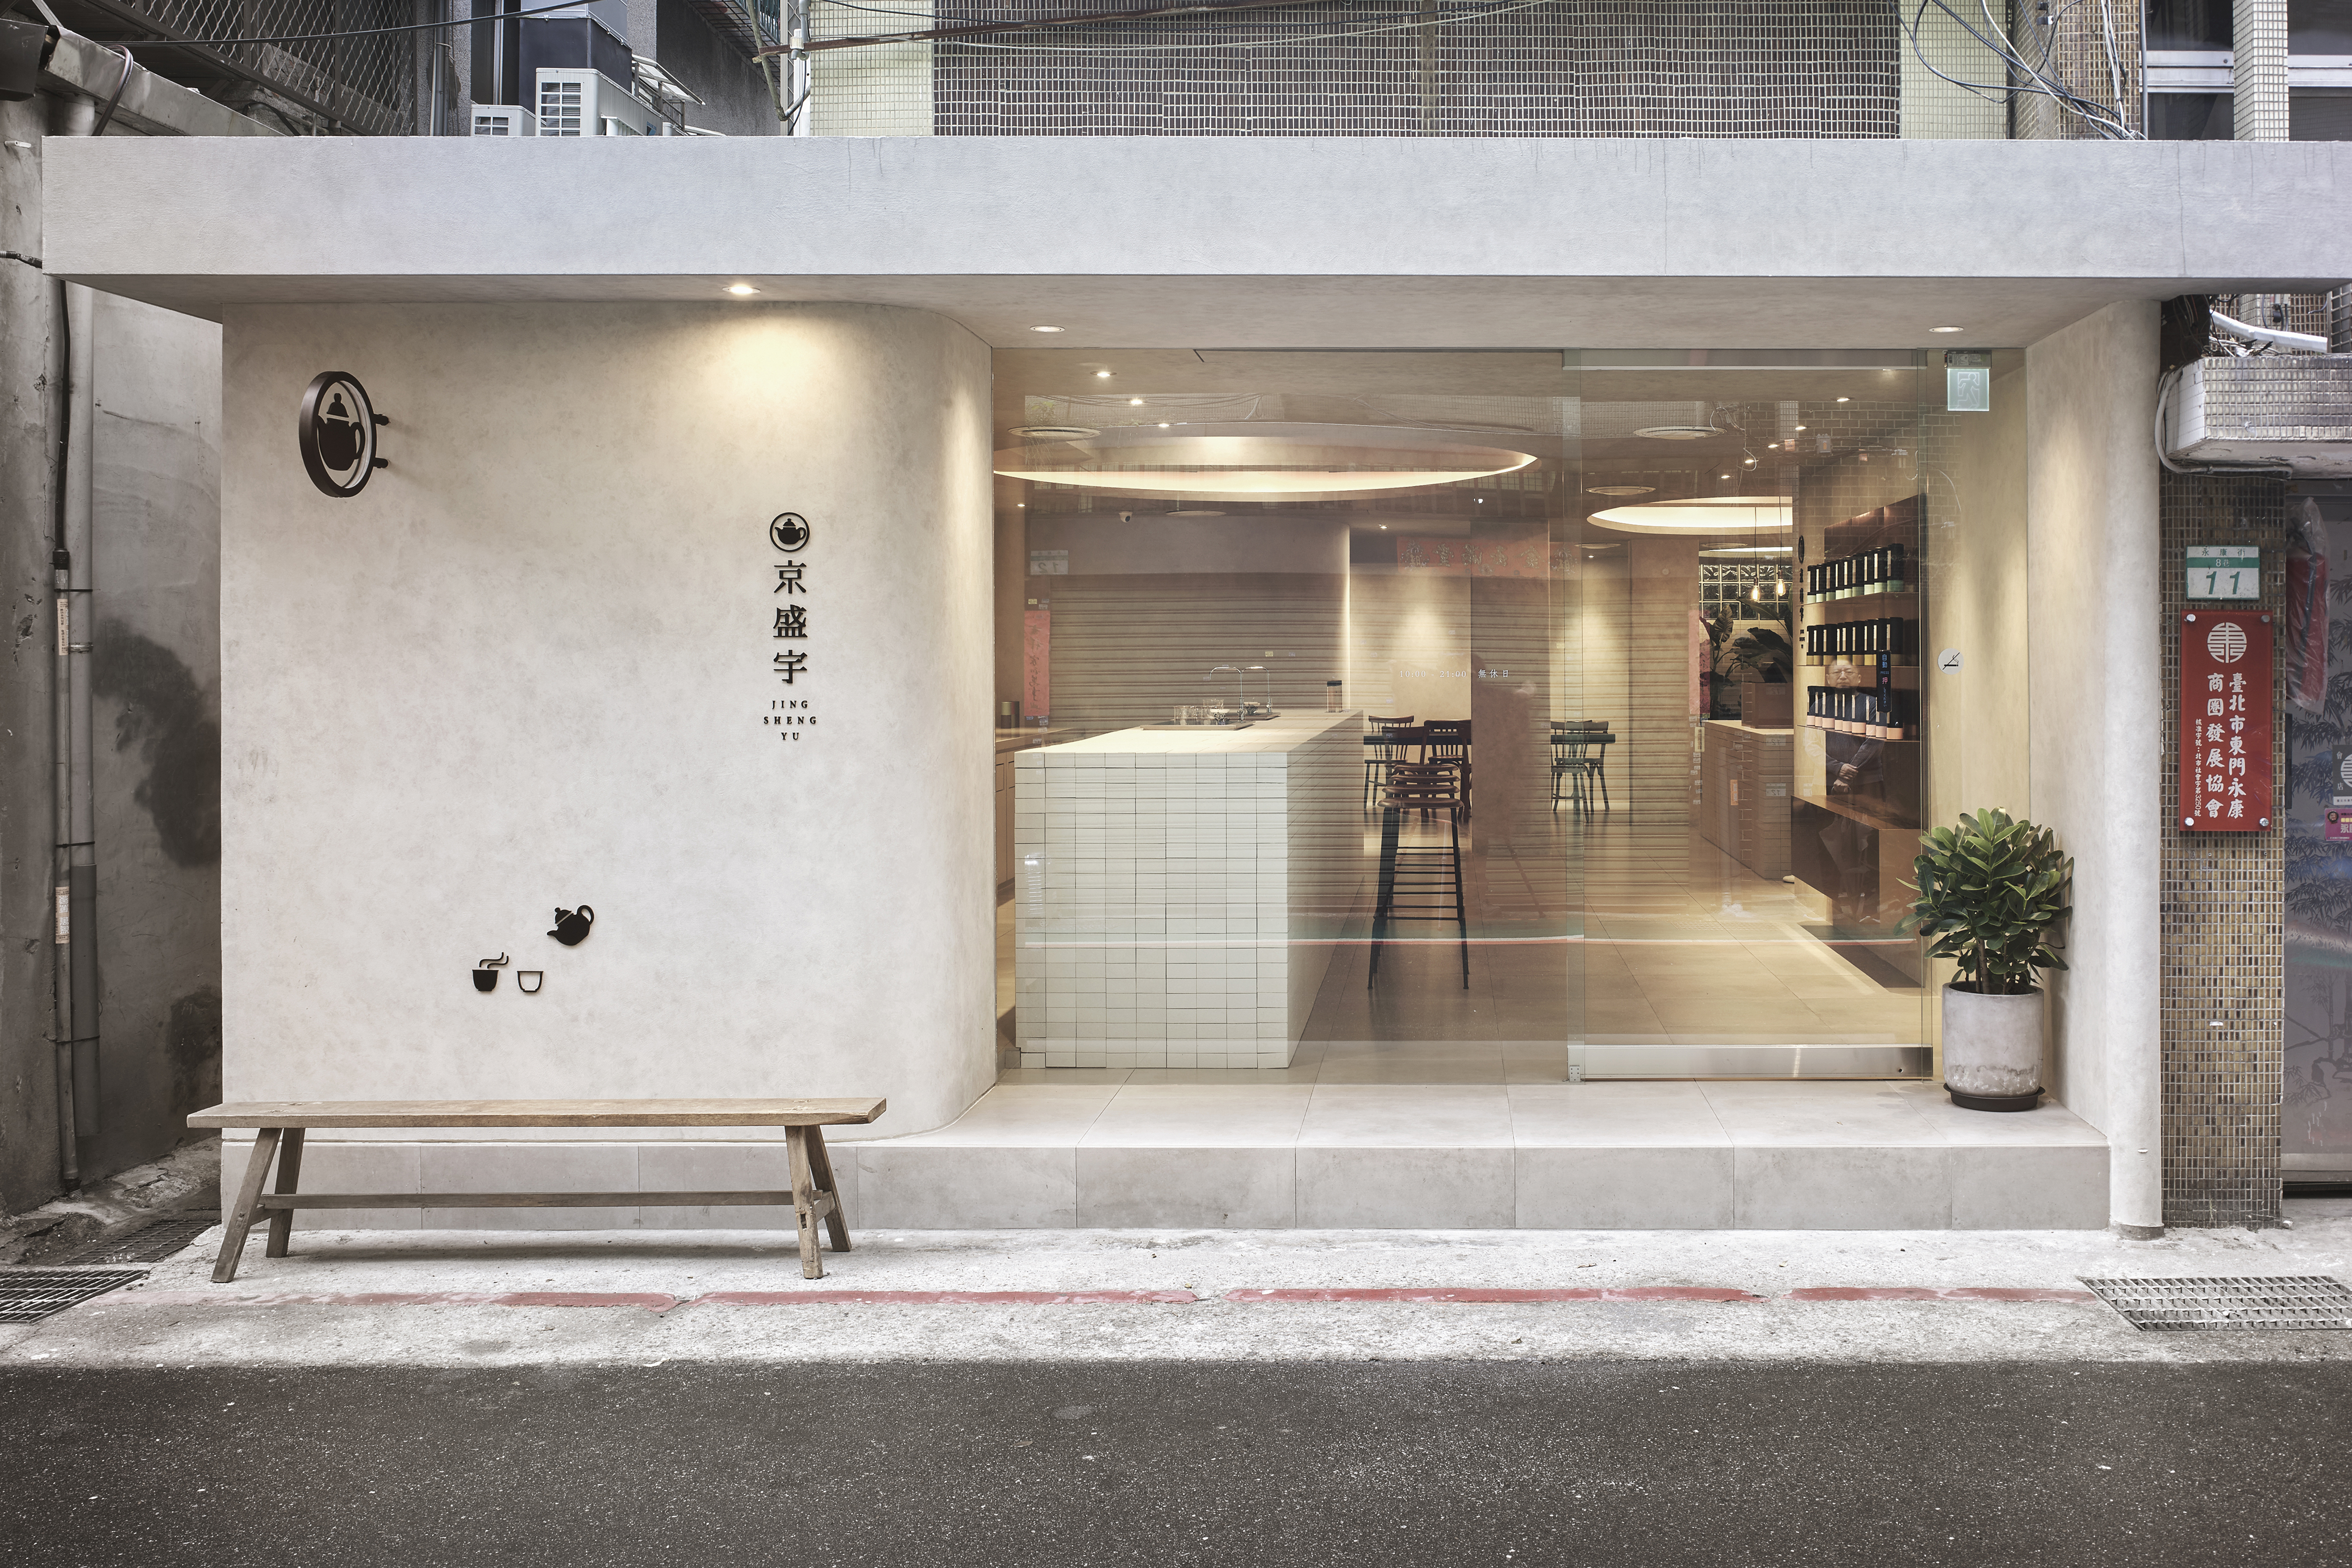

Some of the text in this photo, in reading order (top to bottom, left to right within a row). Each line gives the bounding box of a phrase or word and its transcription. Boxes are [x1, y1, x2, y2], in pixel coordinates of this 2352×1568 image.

[2201, 548, 2246, 556] 永康街
[2215, 558, 2231, 567] 8巷
[2205, 571, 2241, 595] 11
[773, 560, 808, 684] 京盛宇
[1882, 654, 1888, 668] 自動
[1478, 669, 1509, 678] 無休日
[772, 700, 809, 710] JING
[763, 716, 817, 725] SHENG
[781, 732, 800, 741] YU
[2205, 672, 2225, 818] 商圈發展協會
[2228, 672, 2247, 819] 臺北市東門永康
